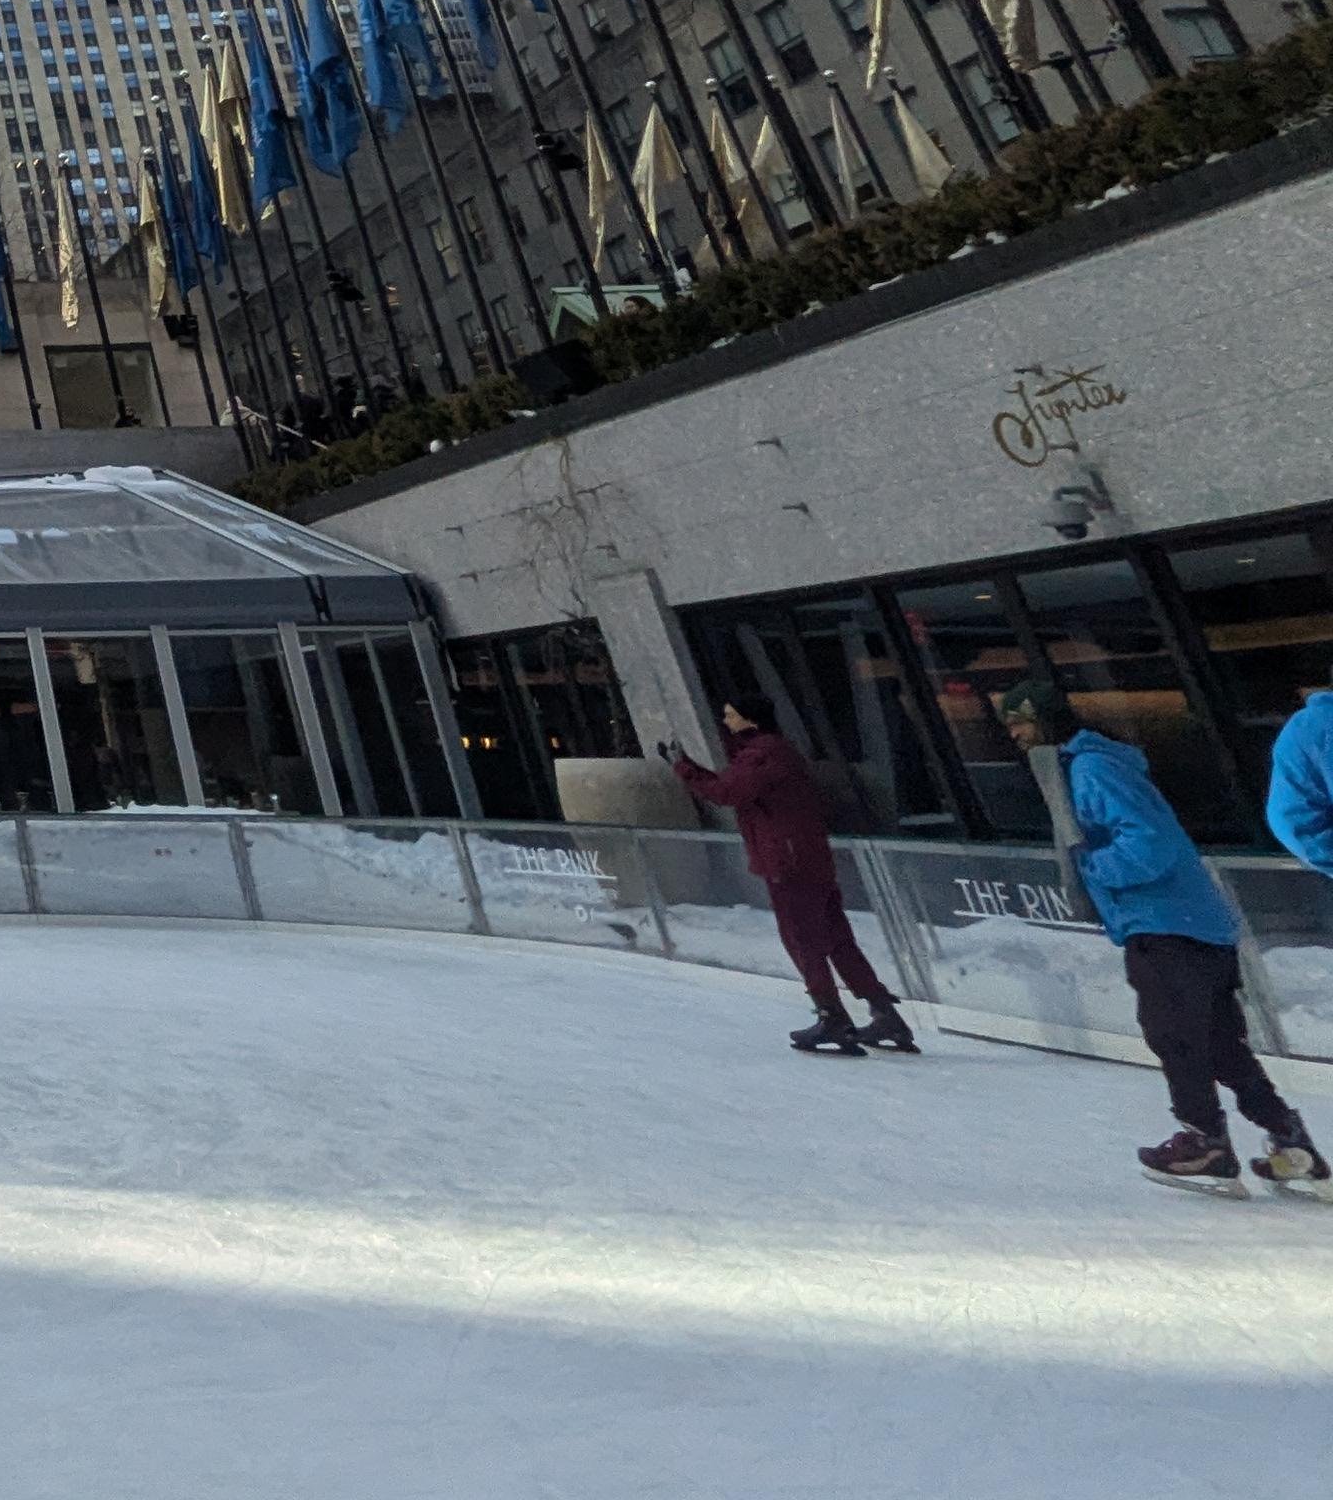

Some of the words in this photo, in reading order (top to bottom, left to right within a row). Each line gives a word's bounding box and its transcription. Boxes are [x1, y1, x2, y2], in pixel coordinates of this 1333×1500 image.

[507, 845, 552, 874] THE
[554, 847, 606, 877] RINK
[953, 878, 1010, 917] THE
[1017, 882, 1075, 924] RIN
